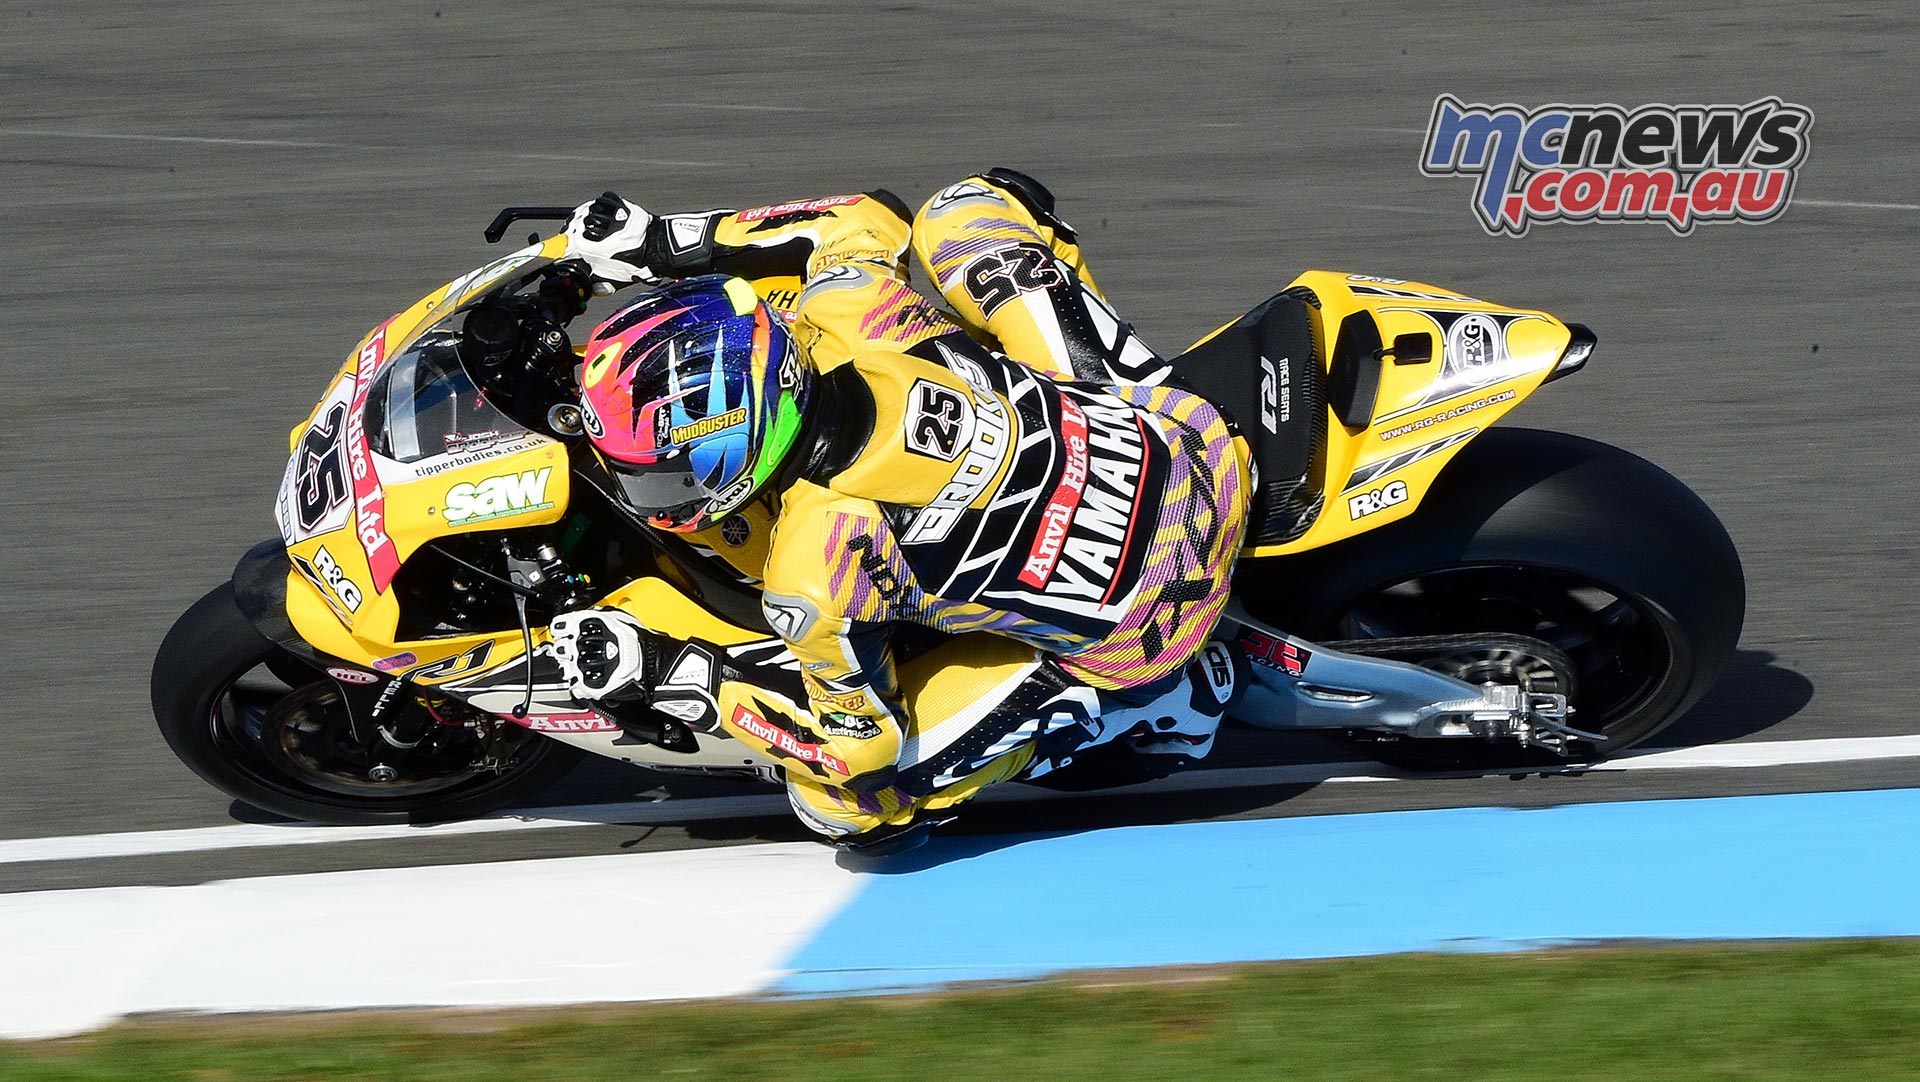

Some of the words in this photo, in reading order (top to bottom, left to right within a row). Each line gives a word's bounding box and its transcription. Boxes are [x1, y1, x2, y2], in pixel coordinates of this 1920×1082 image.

[1463, 323, 1484, 367] R&G
[1279, 357, 1290, 386] RACE
[913, 385, 966, 458] 25
[1280, 386, 1290, 423] SEATS
[1380, 390, 1516, 441] WWW.RG-RACING.COM
[296, 401, 348, 532] 25
[415, 437, 546, 477] tipperbodies.co.uk
[901, 341, 1008, 544] BROOKS
[358, 485, 388, 557] Ltd
[1024, 500, 1074, 581] Anvil
[1062, 434, 1089, 494] Hire
[1045, 395, 1142, 600] YAMAHA
[1350, 481, 1408, 520] R&G
[313, 546, 362, 614] R&G
[1246, 653, 1304, 678] ACING
[371, 677, 402, 717] RELLI
[737, 711, 780, 744] Anvil
[781, 734, 814, 760] Hire
